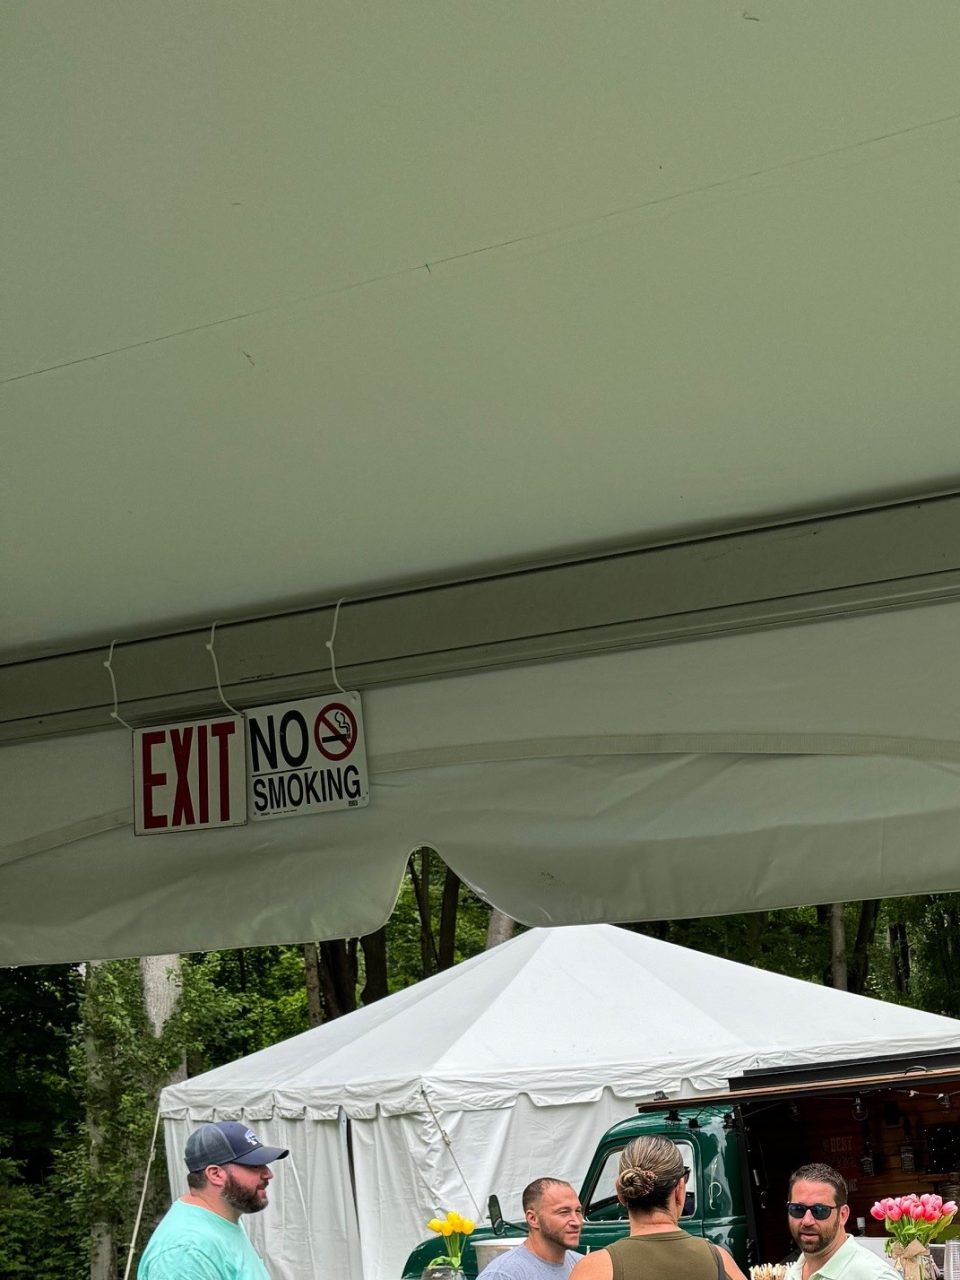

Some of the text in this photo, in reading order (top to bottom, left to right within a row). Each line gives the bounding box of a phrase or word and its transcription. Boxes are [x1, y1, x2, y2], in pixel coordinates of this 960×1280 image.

[249, 709, 309, 772] NO
[142, 721, 236, 829] EXIT
[253, 765, 361, 811] SMOKING
